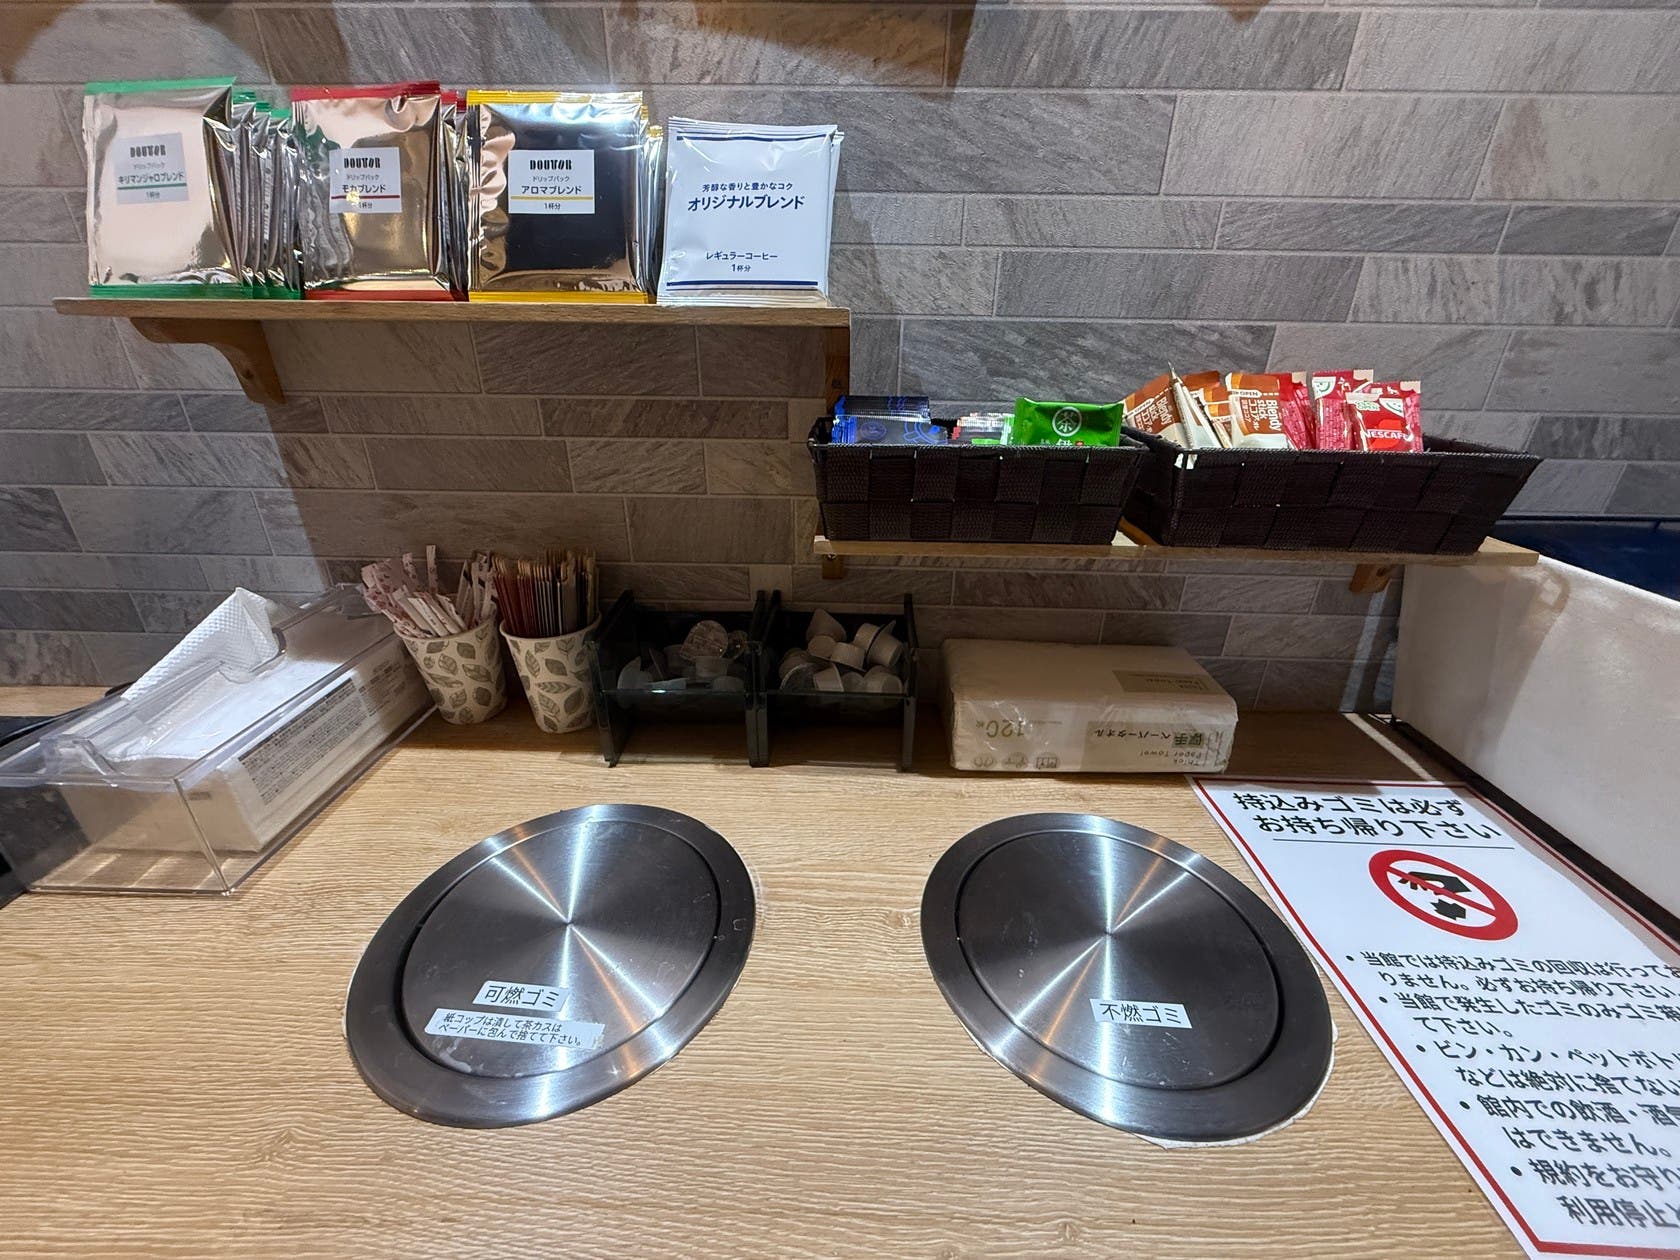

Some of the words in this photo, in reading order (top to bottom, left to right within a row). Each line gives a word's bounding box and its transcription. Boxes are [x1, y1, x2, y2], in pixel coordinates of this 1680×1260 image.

[130, 145, 166, 158] DOUTOR
[343, 157, 381, 169] DOUTOR
[529, 159, 572, 170] DOUTOR
[118, 170, 184, 184] キリマンジャロブレンド
[342, 184, 387, 193] モカブレンド
[521, 185, 582, 195] アロマブレンド
[702, 182, 793, 193] 芳醇な香りと豊かなコク
[544, 202, 561, 211] 1杯分
[687, 194, 805, 212] オリジナルブレンド
[706, 251, 778, 261] レギュラーコーヒー
[731, 263, 751, 272] 1杯分
[1156, 396, 1173, 426] Blendy
[1256, 399, 1268, 419] stick
[1265, 399, 1283, 432] Blendy
[1093, 728, 1172, 740] ペーパータオル
[1233, 792, 1465, 816] 持込みゴミは必ず
[1254, 814, 1502, 840] お持ち帰り下さい
[1378, 970, 1680, 1001] りません。必ずお持ち帰り下さい
[484, 985, 560, 1008] 可燃ゴミ
[443, 1012, 563, 1033] 紙コップは潰して茶カスは
[1099, 1003, 1182, 1024] 不燃ゴミ
[438, 1023, 582, 1046] ペーパーに包んで捨てて下さい。
[1417, 1016, 1513, 1038] て下さい。
[1503, 1126, 1672, 1158] はできません。
